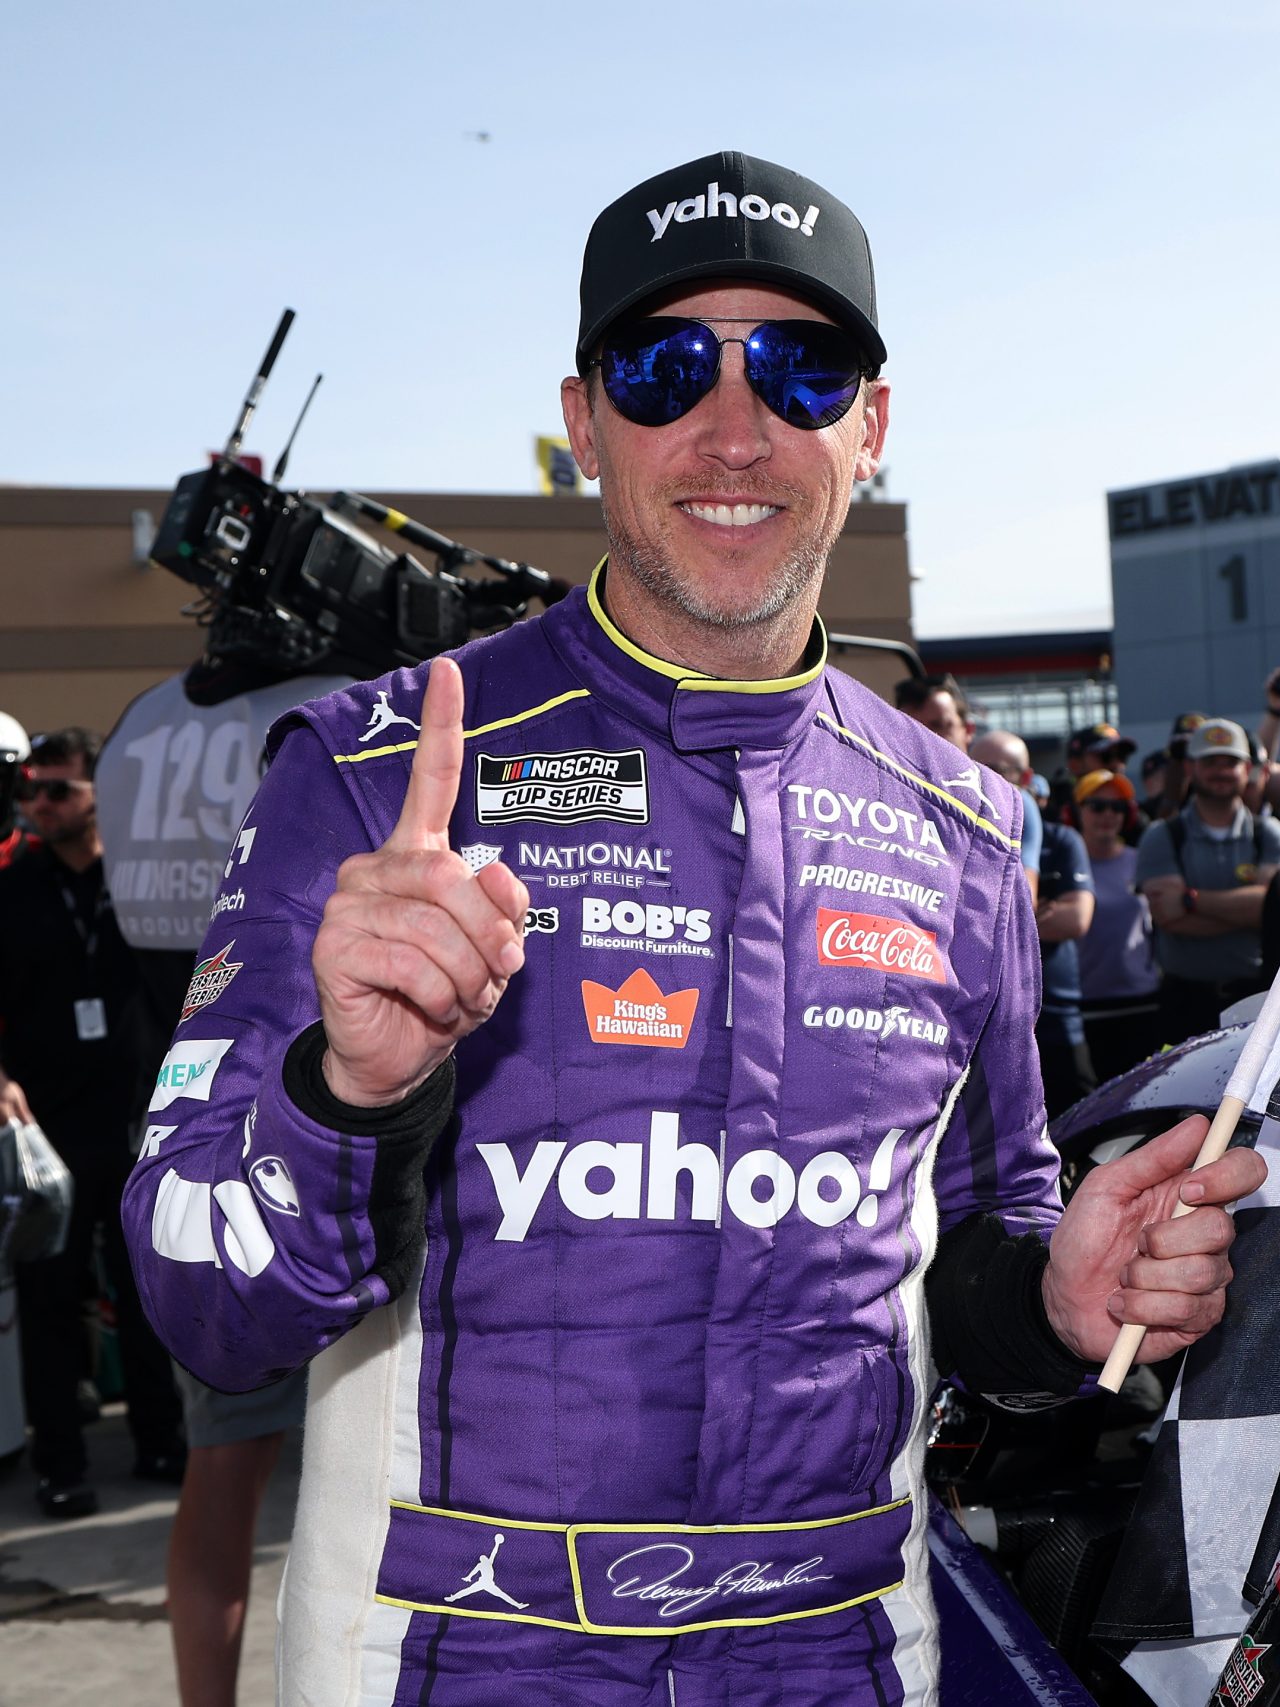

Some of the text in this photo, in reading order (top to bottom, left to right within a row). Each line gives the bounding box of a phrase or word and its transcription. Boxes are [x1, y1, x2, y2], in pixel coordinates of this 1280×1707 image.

[646, 182, 820, 243] yahoo!
[1218, 554, 1248, 623] 1
[125, 719, 250, 842] 129
[530, 756, 619, 782] NASCAR
[501, 784, 623, 808] CUP SERIES
[787, 784, 948, 856] TOYOTA
[519, 842, 671, 873] NATIONAL
[791, 825, 951, 867] RACING
[548, 871, 643, 889] DEBT RELIEF
[799, 864, 944, 913] PROGRESSIVE
[582, 897, 712, 942] BOB'S
[582, 934, 643, 950] Discount
[822, 918, 934, 974] Coca-Cola
[596, 1015, 683, 1038] Hawaiian
[613, 1000, 667, 1020] King's
[475, 1111, 906, 1242] yahoo!
